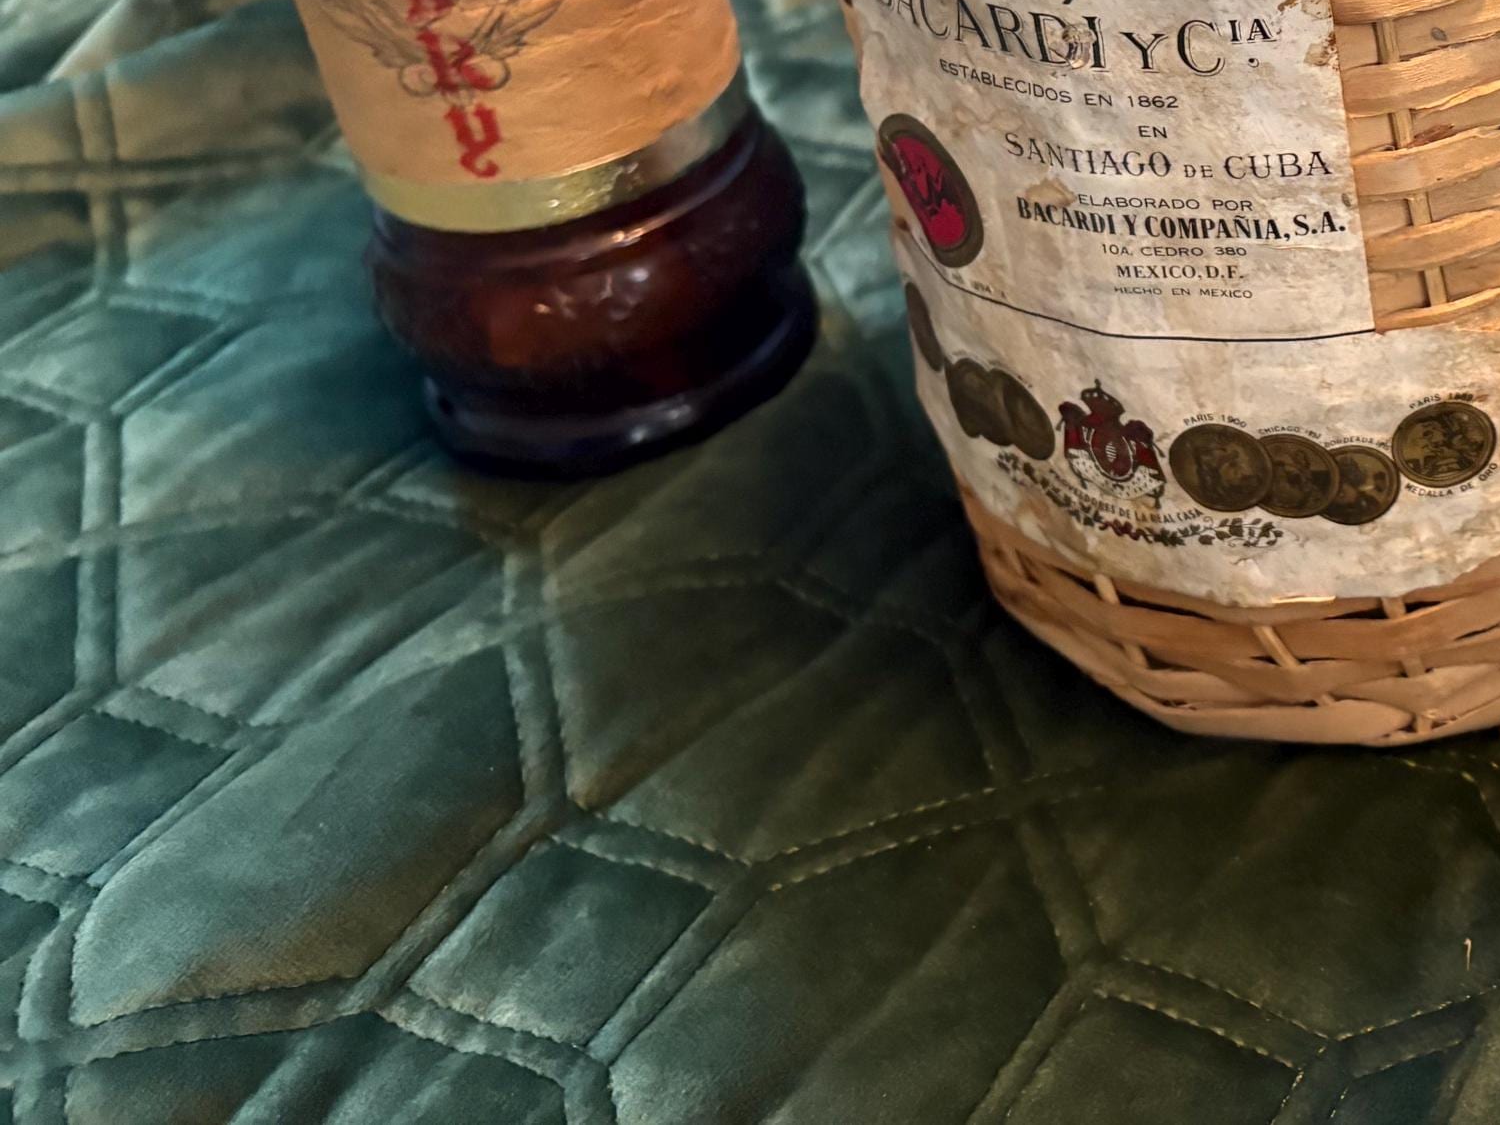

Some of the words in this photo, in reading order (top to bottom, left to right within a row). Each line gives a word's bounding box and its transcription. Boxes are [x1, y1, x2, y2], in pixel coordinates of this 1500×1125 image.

[1122, 29, 1170, 70] Y
[939, 58, 1072, 105] ESTABLECIDOS
[1084, 92, 1114, 108] EN
[1128, 94, 1179, 110] 1862
[1138, 125, 1168, 139] EN
[1004, 131, 1172, 178] SANTIAGO
[1183, 163, 1214, 179] DE
[1223, 150, 1334, 180] CUBA
[1078, 193, 1200, 211] ELABORADO
[1212, 198, 1254, 212] POR
[1017, 196, 1116, 235] BACARDI
[1119, 213, 1138, 238] Y
[1145, 213, 1291, 242] COMPAÑIA,
[1293, 210, 1347, 238] S.A.
[1140, 245, 1204, 258] CEDRO
[1213, 246, 1248, 257] 380
[1205, 264, 1246, 280] D.F.
[1114, 286, 1163, 296] HECHO
[1171, 287, 1192, 296] EN
[1200, 288, 1254, 300] MEXICO
[1183, 413, 1214, 426] PARIS
[1221, 414, 1248, 428] 1900
[1258, 425, 1301, 435] CHICAGO
[1404, 483, 1454, 498] MEDALLA
[1459, 481, 1476, 493] DE
[1478, 462, 1499, 483] ORO
[1119, 508, 1132, 519] DE
[1134, 512, 1148, 523] LA
[1150, 512, 1176, 525] REAL
[1178, 507, 1205, 523] CASA
